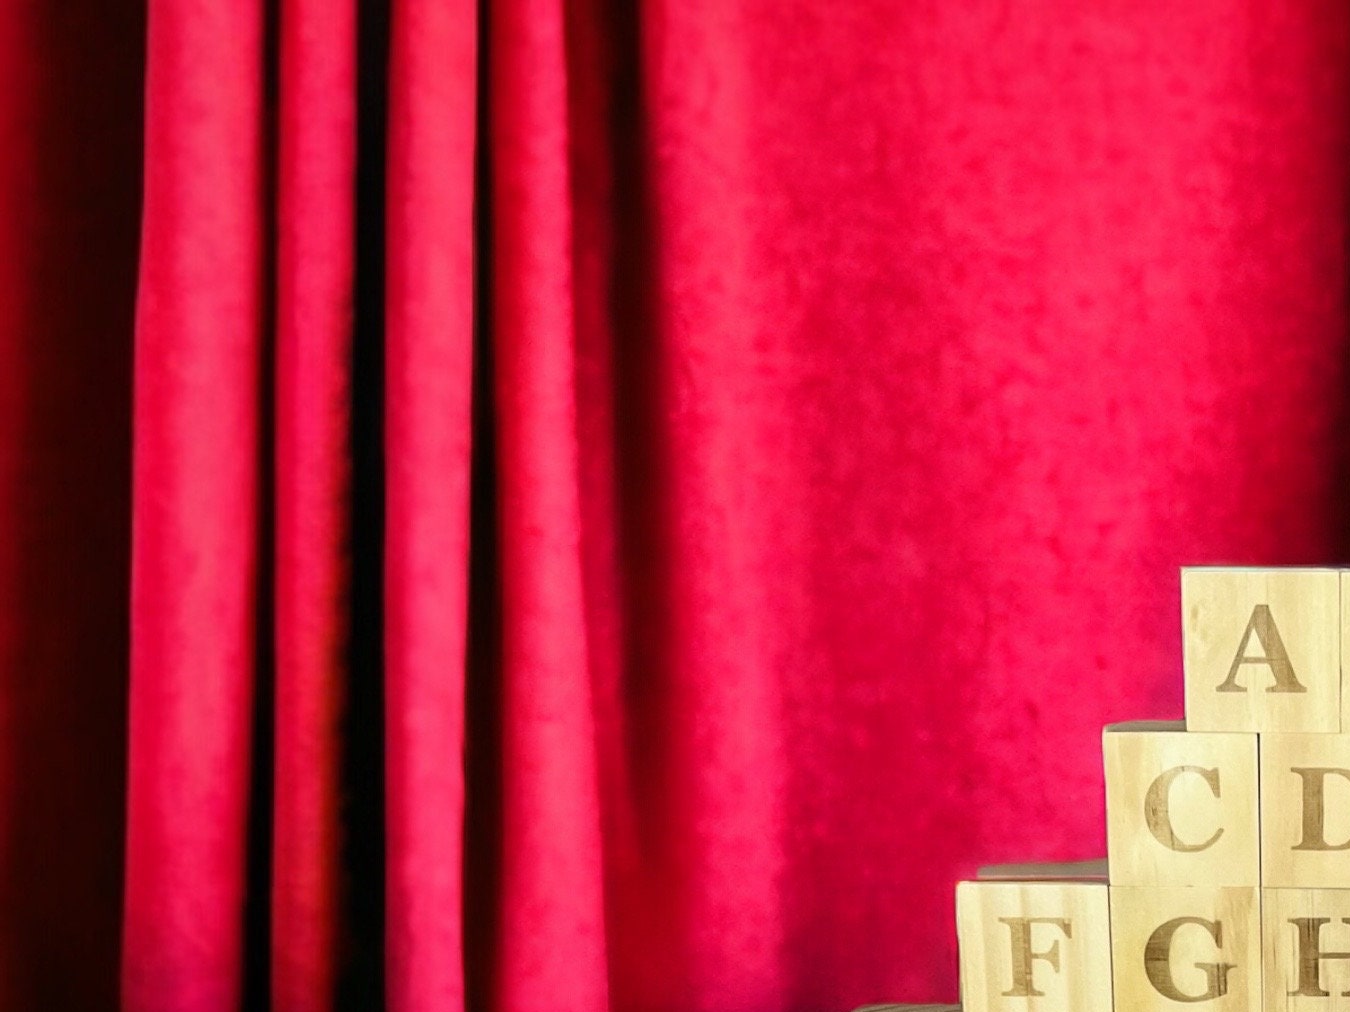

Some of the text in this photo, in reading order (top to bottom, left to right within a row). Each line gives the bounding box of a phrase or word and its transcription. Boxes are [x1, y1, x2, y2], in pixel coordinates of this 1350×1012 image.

[1216, 604, 1308, 693] A
[1144, 765, 1225, 852] C
[998, 917, 1072, 998] F
[1143, 916, 1238, 1002] G
